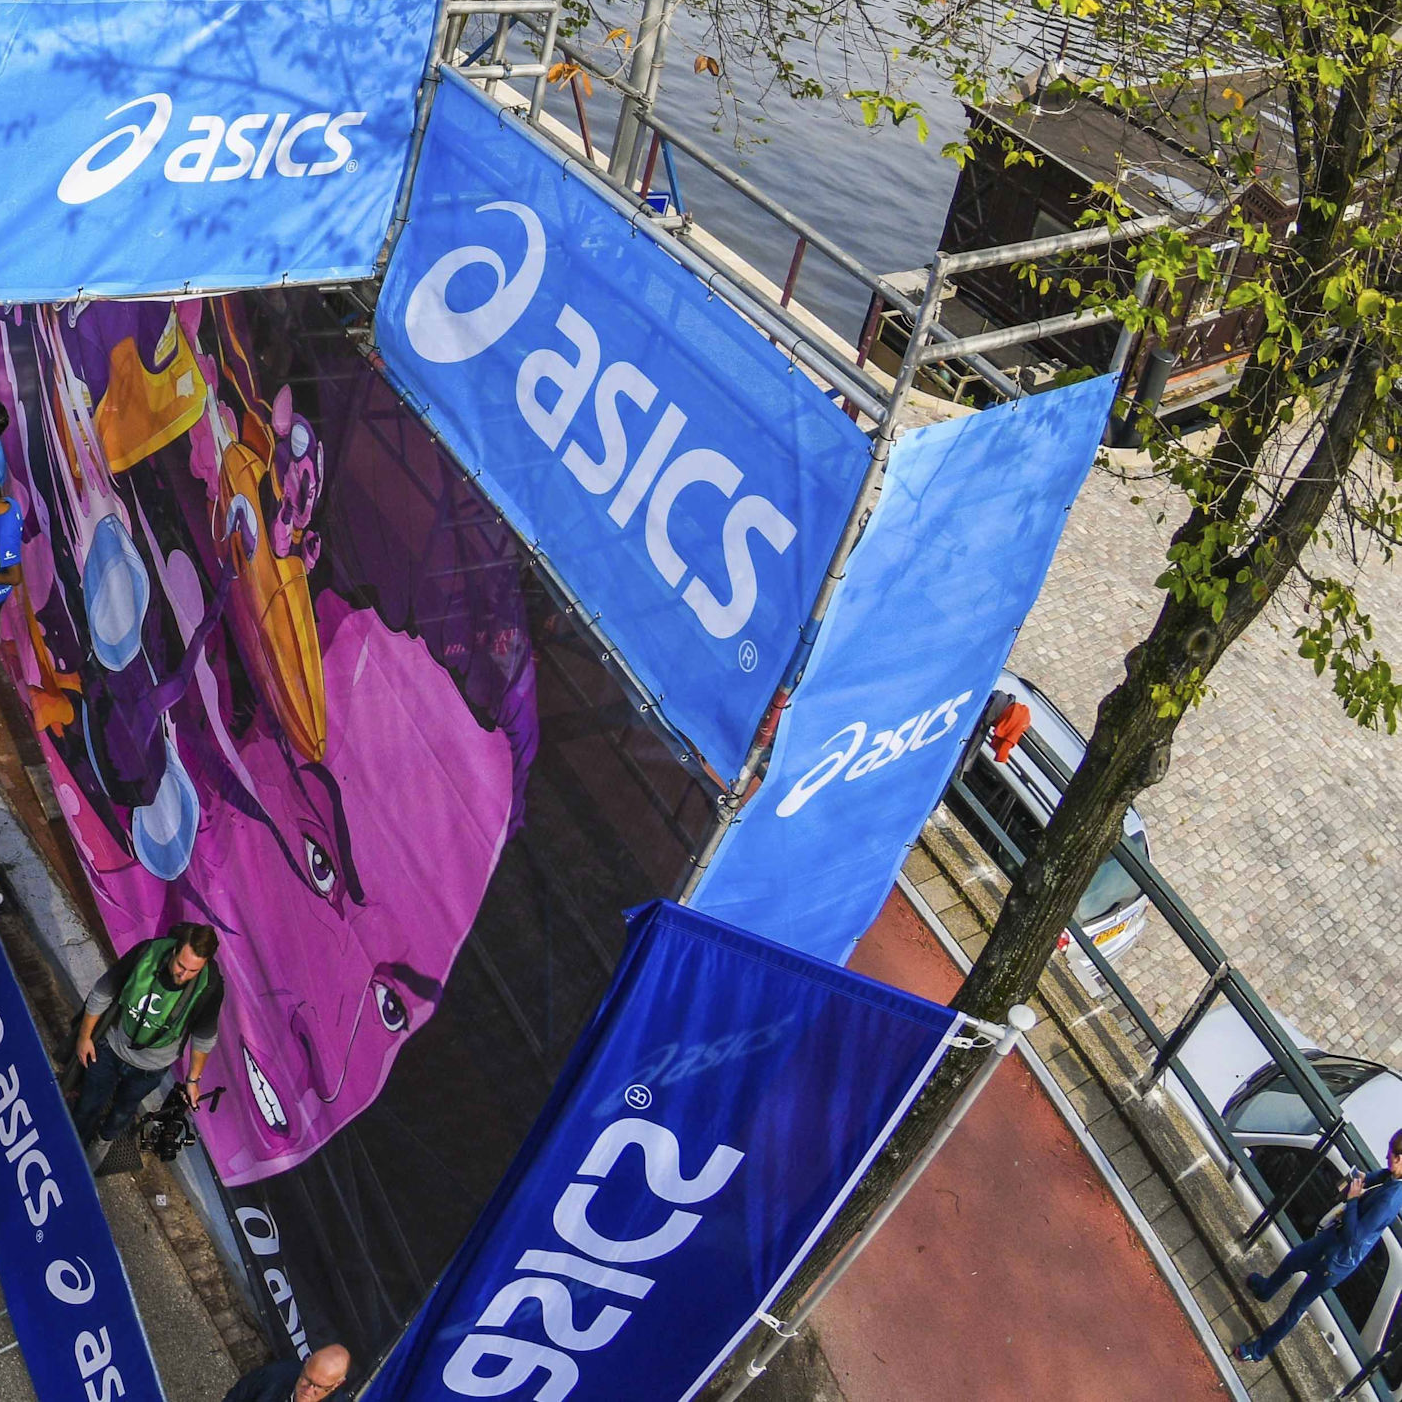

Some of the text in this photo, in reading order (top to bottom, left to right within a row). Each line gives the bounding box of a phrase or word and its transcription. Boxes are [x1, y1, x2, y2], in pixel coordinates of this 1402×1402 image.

[162, 110, 368, 185] asics
[515, 302, 798, 640] asics
[849, 688, 973, 784] asics
